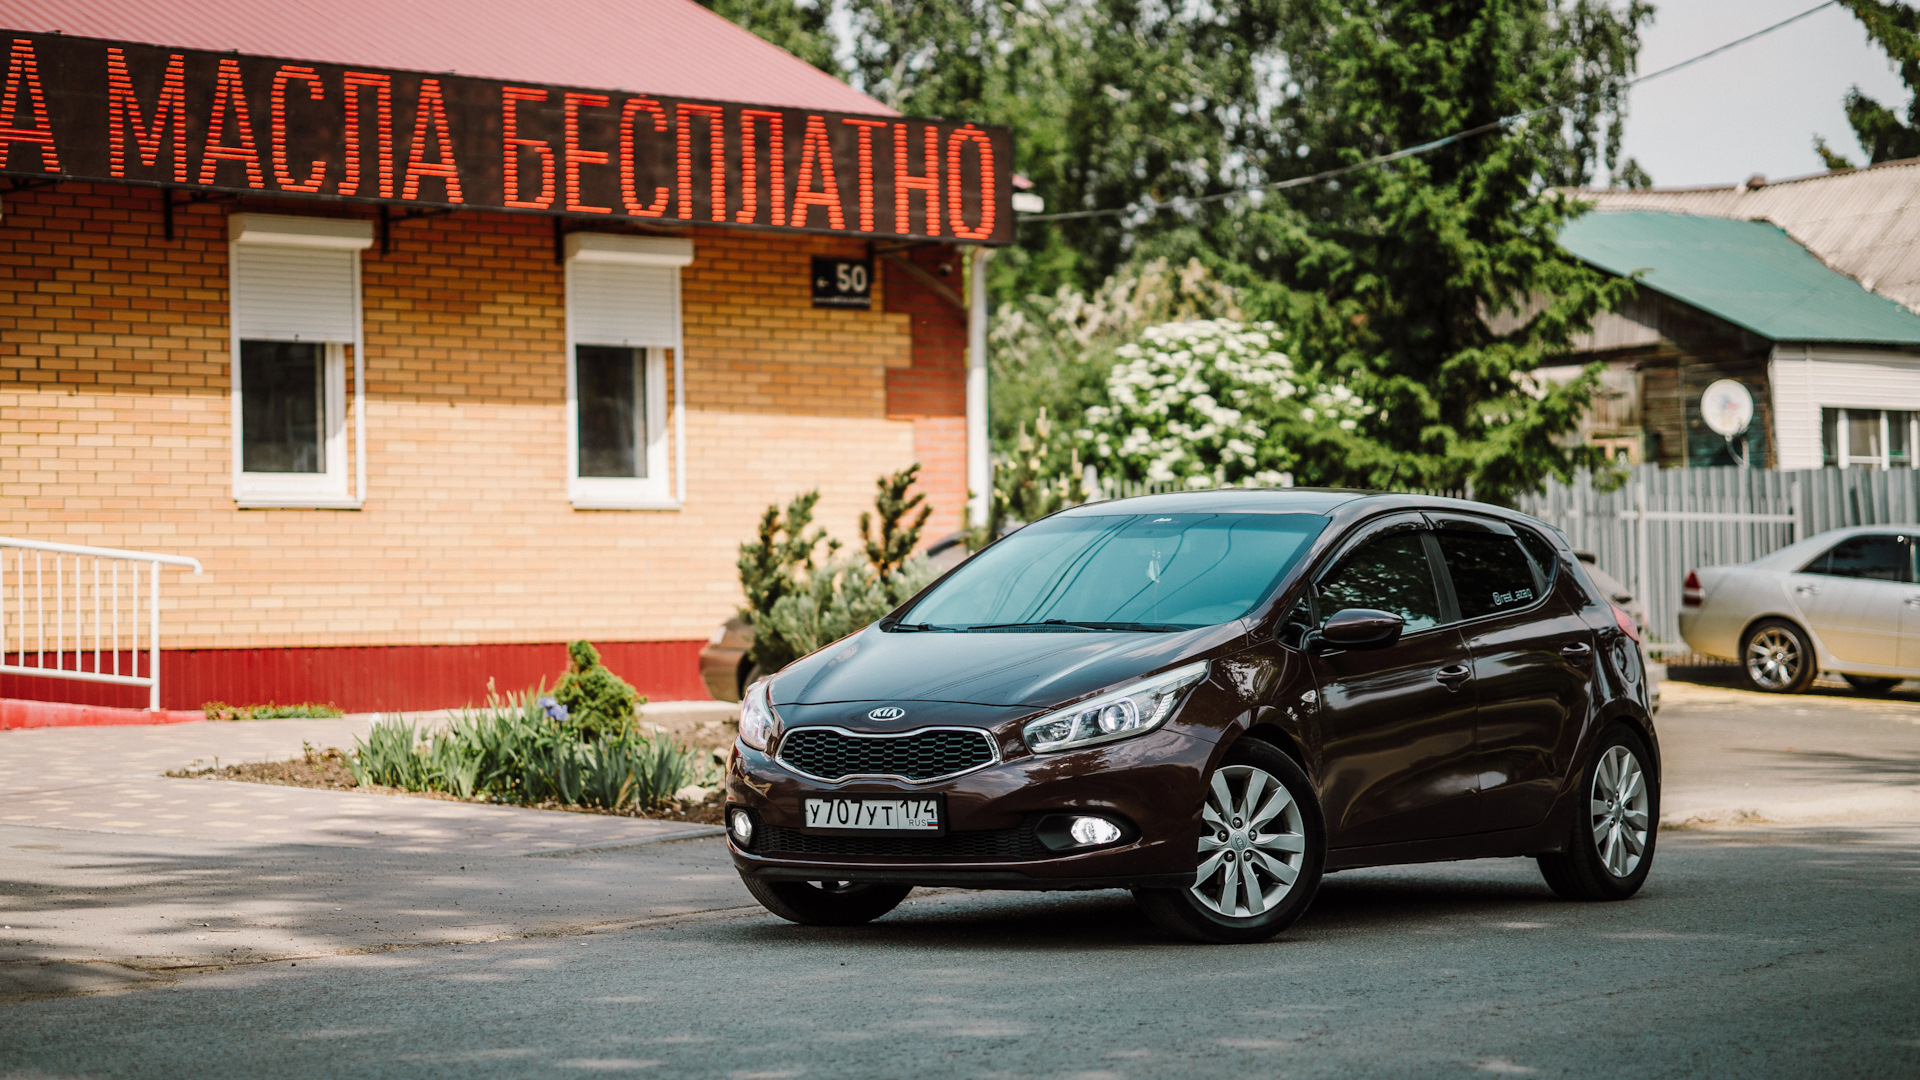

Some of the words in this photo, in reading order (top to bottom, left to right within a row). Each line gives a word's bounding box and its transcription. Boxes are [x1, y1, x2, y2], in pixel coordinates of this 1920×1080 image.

[107, 47, 464, 204] МАСЛА
[502, 86, 996, 240] БЕСПЛАТНО
[836, 263, 867, 293] 50
[872, 708, 898, 718] KIA
[899, 799, 935, 819] 174
[908, 818, 927, 827] RUS
